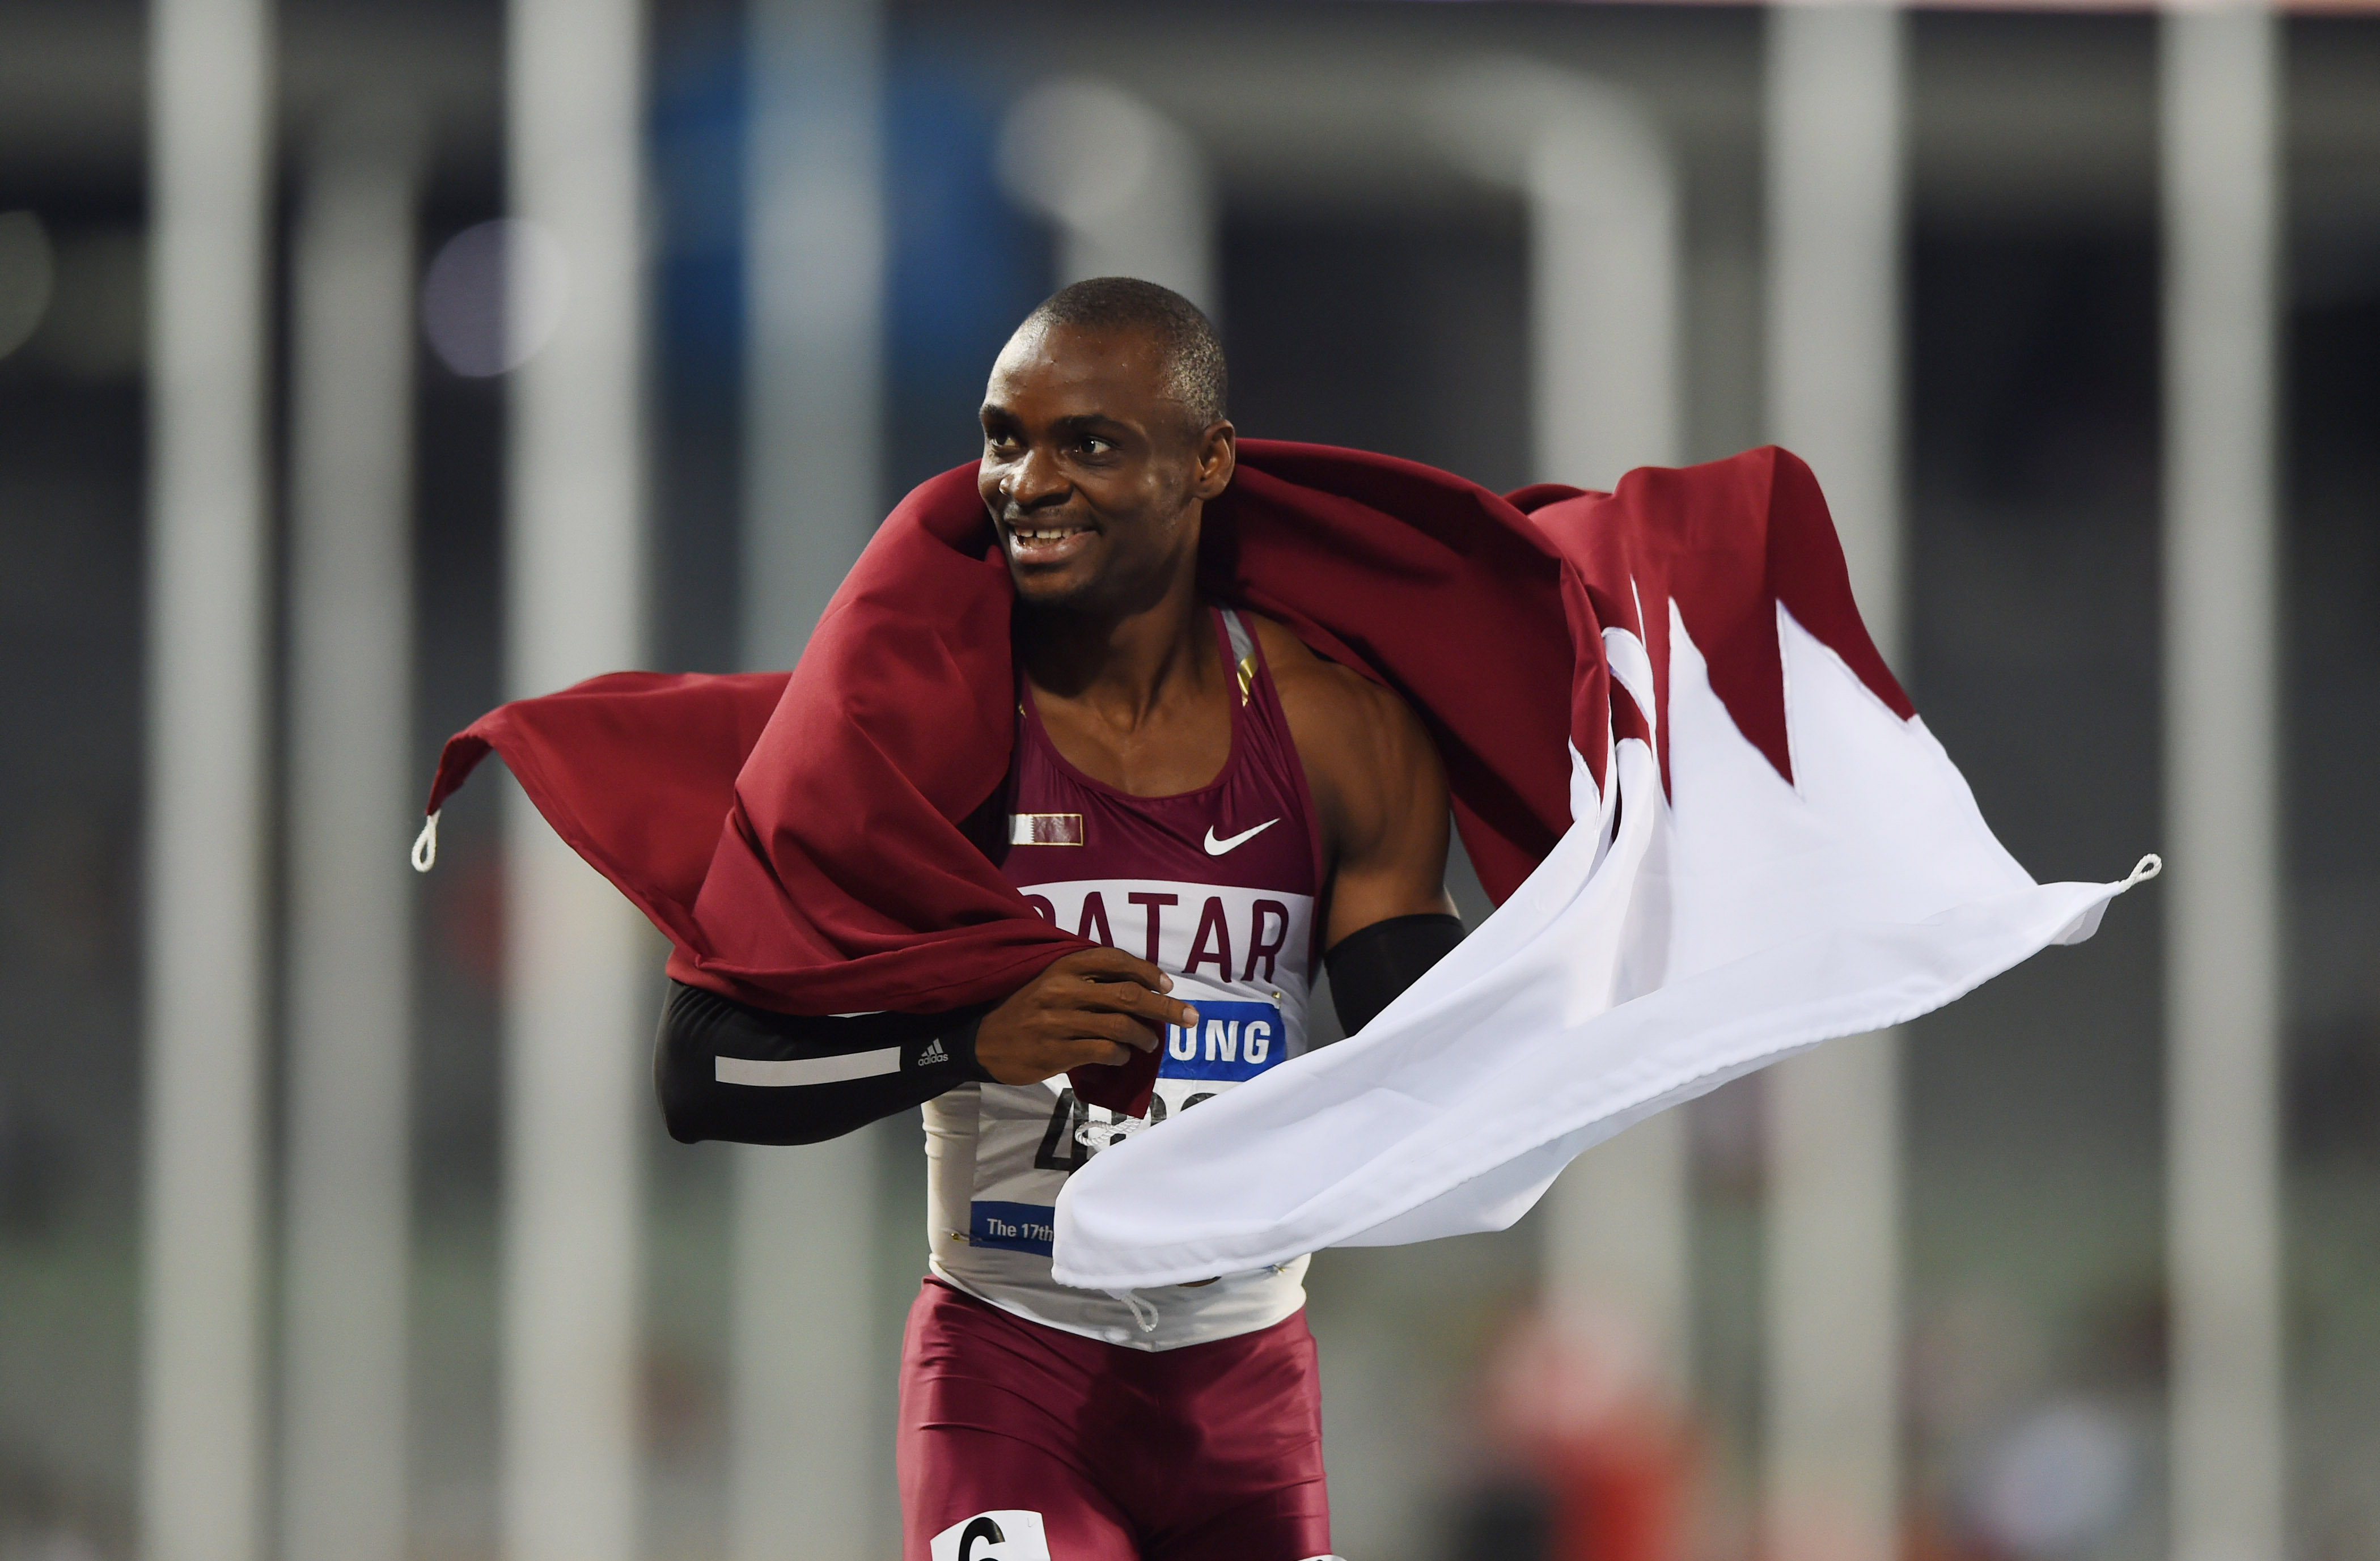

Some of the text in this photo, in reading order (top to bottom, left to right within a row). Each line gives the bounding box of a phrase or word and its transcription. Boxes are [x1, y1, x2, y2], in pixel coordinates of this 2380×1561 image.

[918, 1054, 948, 1066] adidas
[987, 1218, 1053, 1242] The 17th
